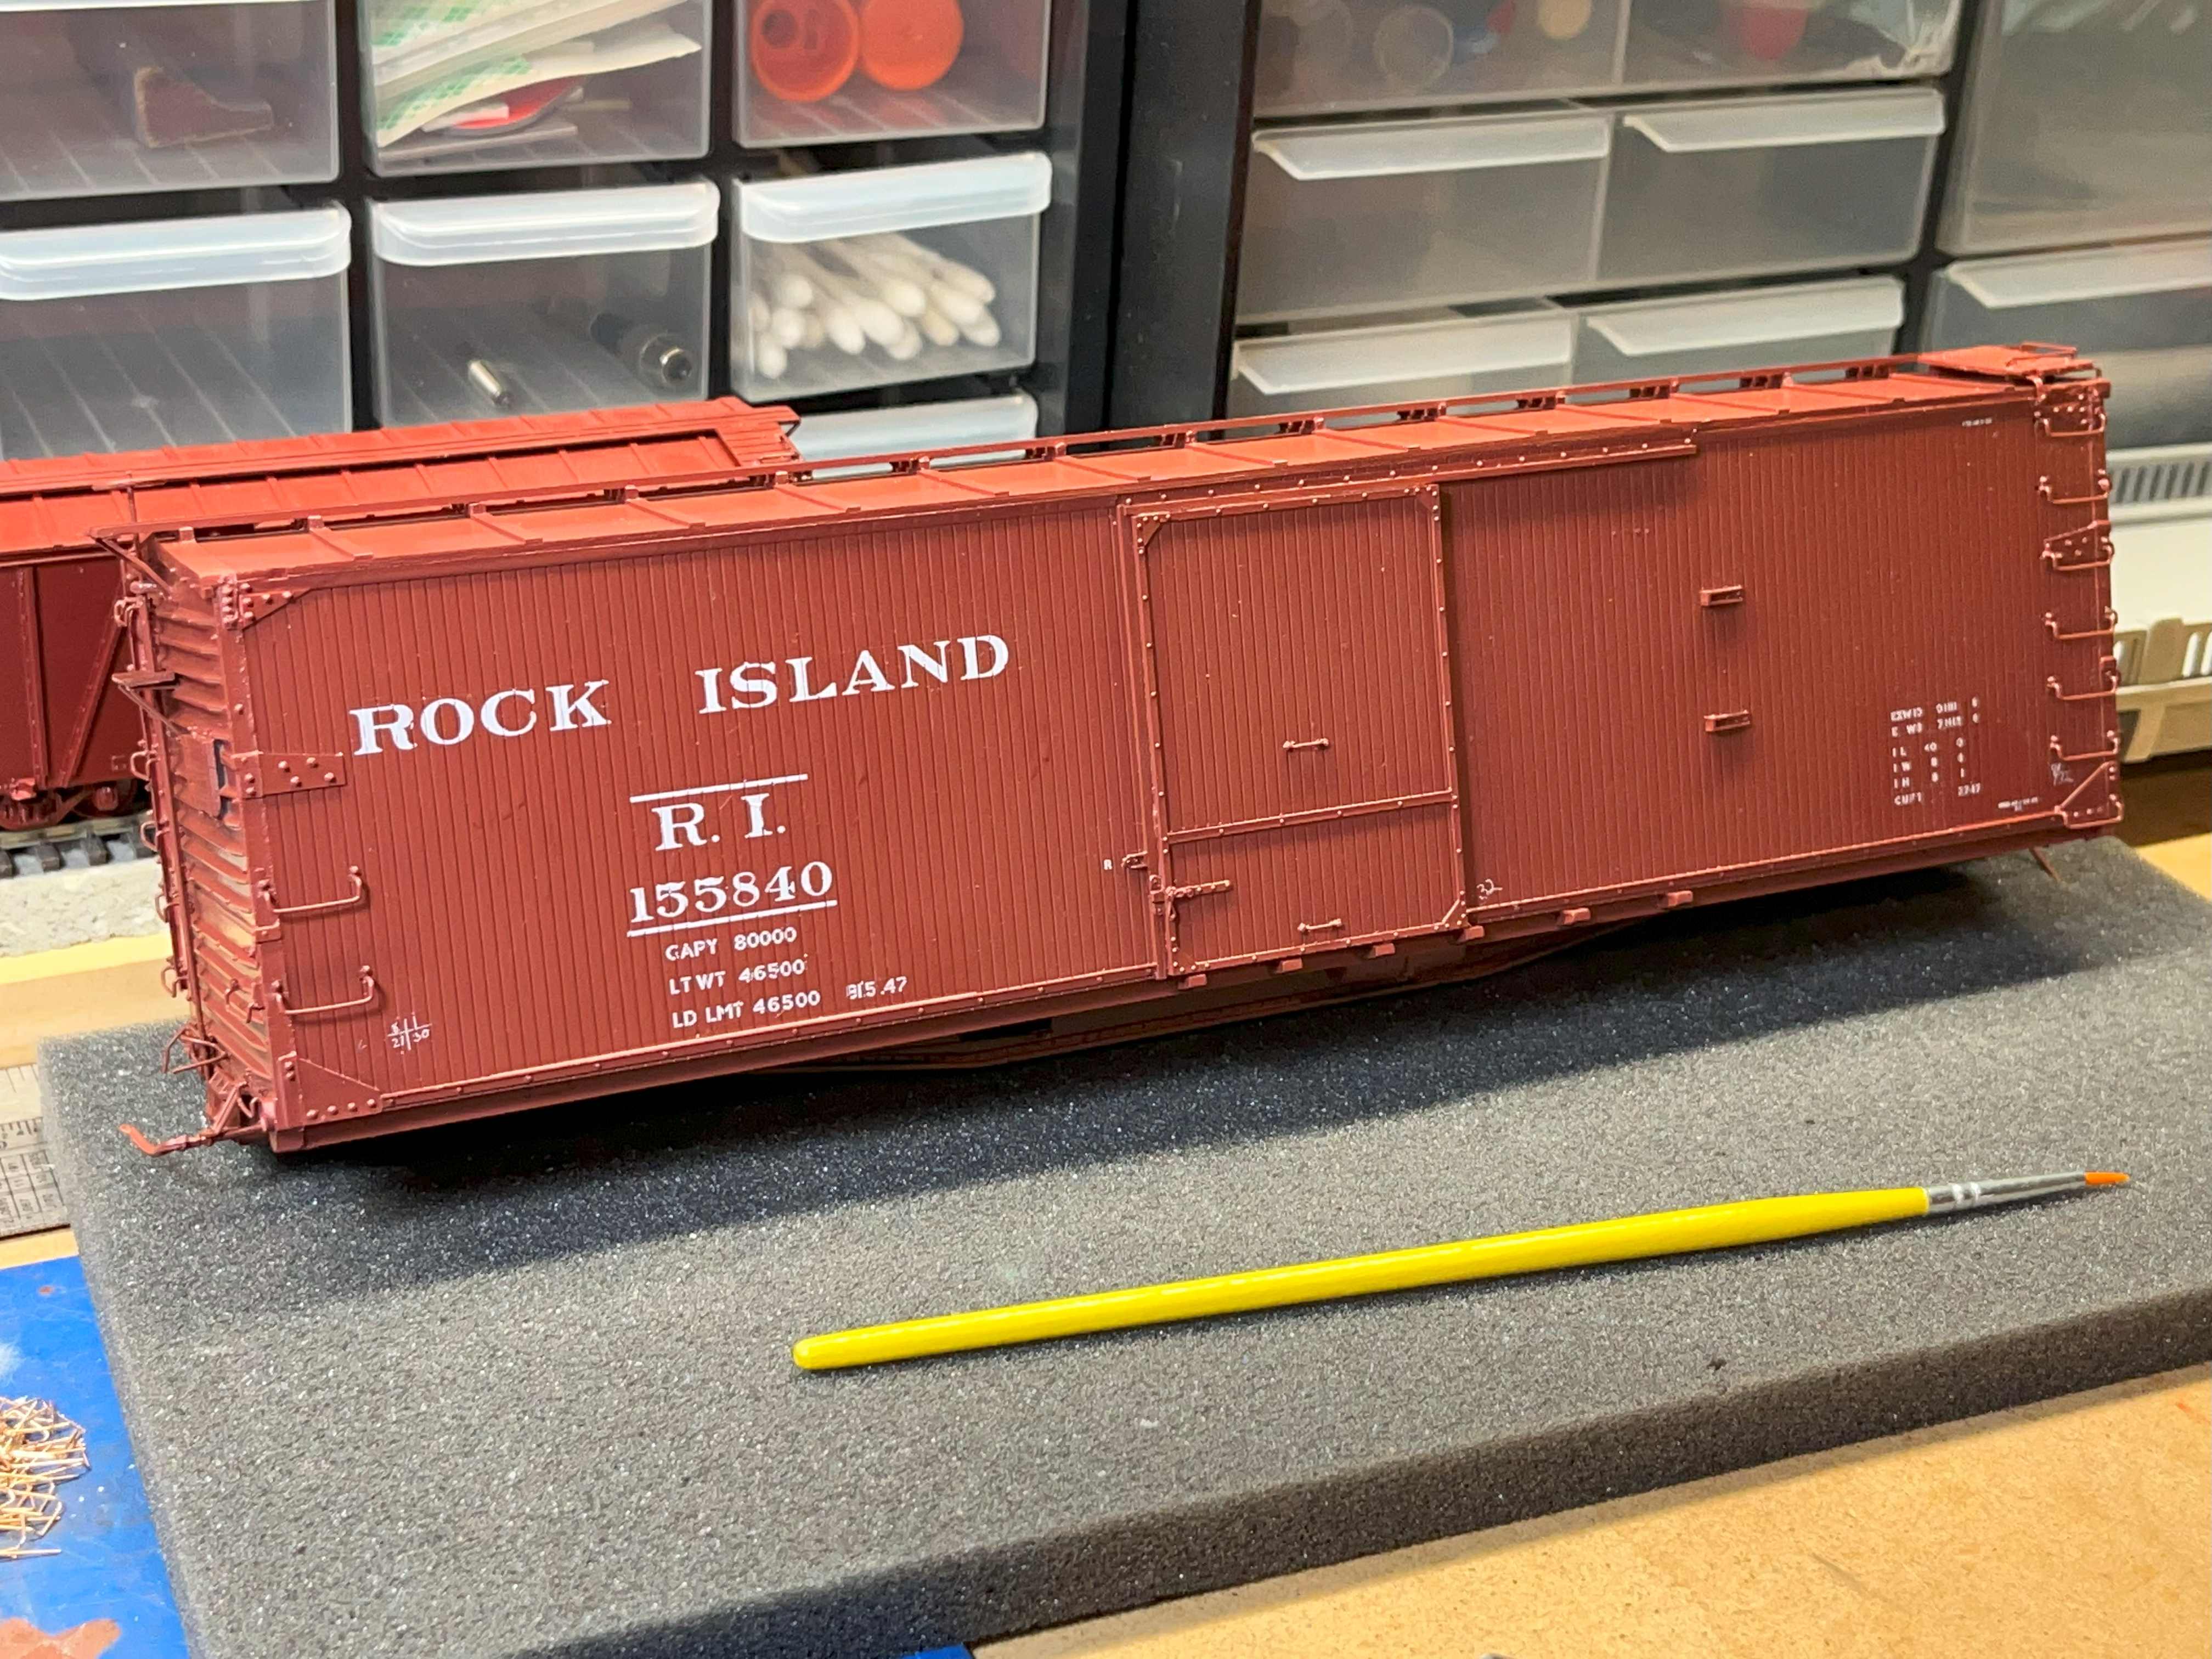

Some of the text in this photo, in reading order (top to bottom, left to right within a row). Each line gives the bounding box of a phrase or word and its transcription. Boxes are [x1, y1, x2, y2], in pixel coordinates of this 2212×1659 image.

[349, 634, 1009, 756] ROCK ISLAND
[651, 792, 786, 851] R. I.
[1103, 859, 1113, 870] R
[629, 861, 833, 923] 155840
[665, 927, 797, 961] CAPY 80000
[738, 958, 805, 983] 46500
[672, 990, 821, 1029] LD LMT 46500
